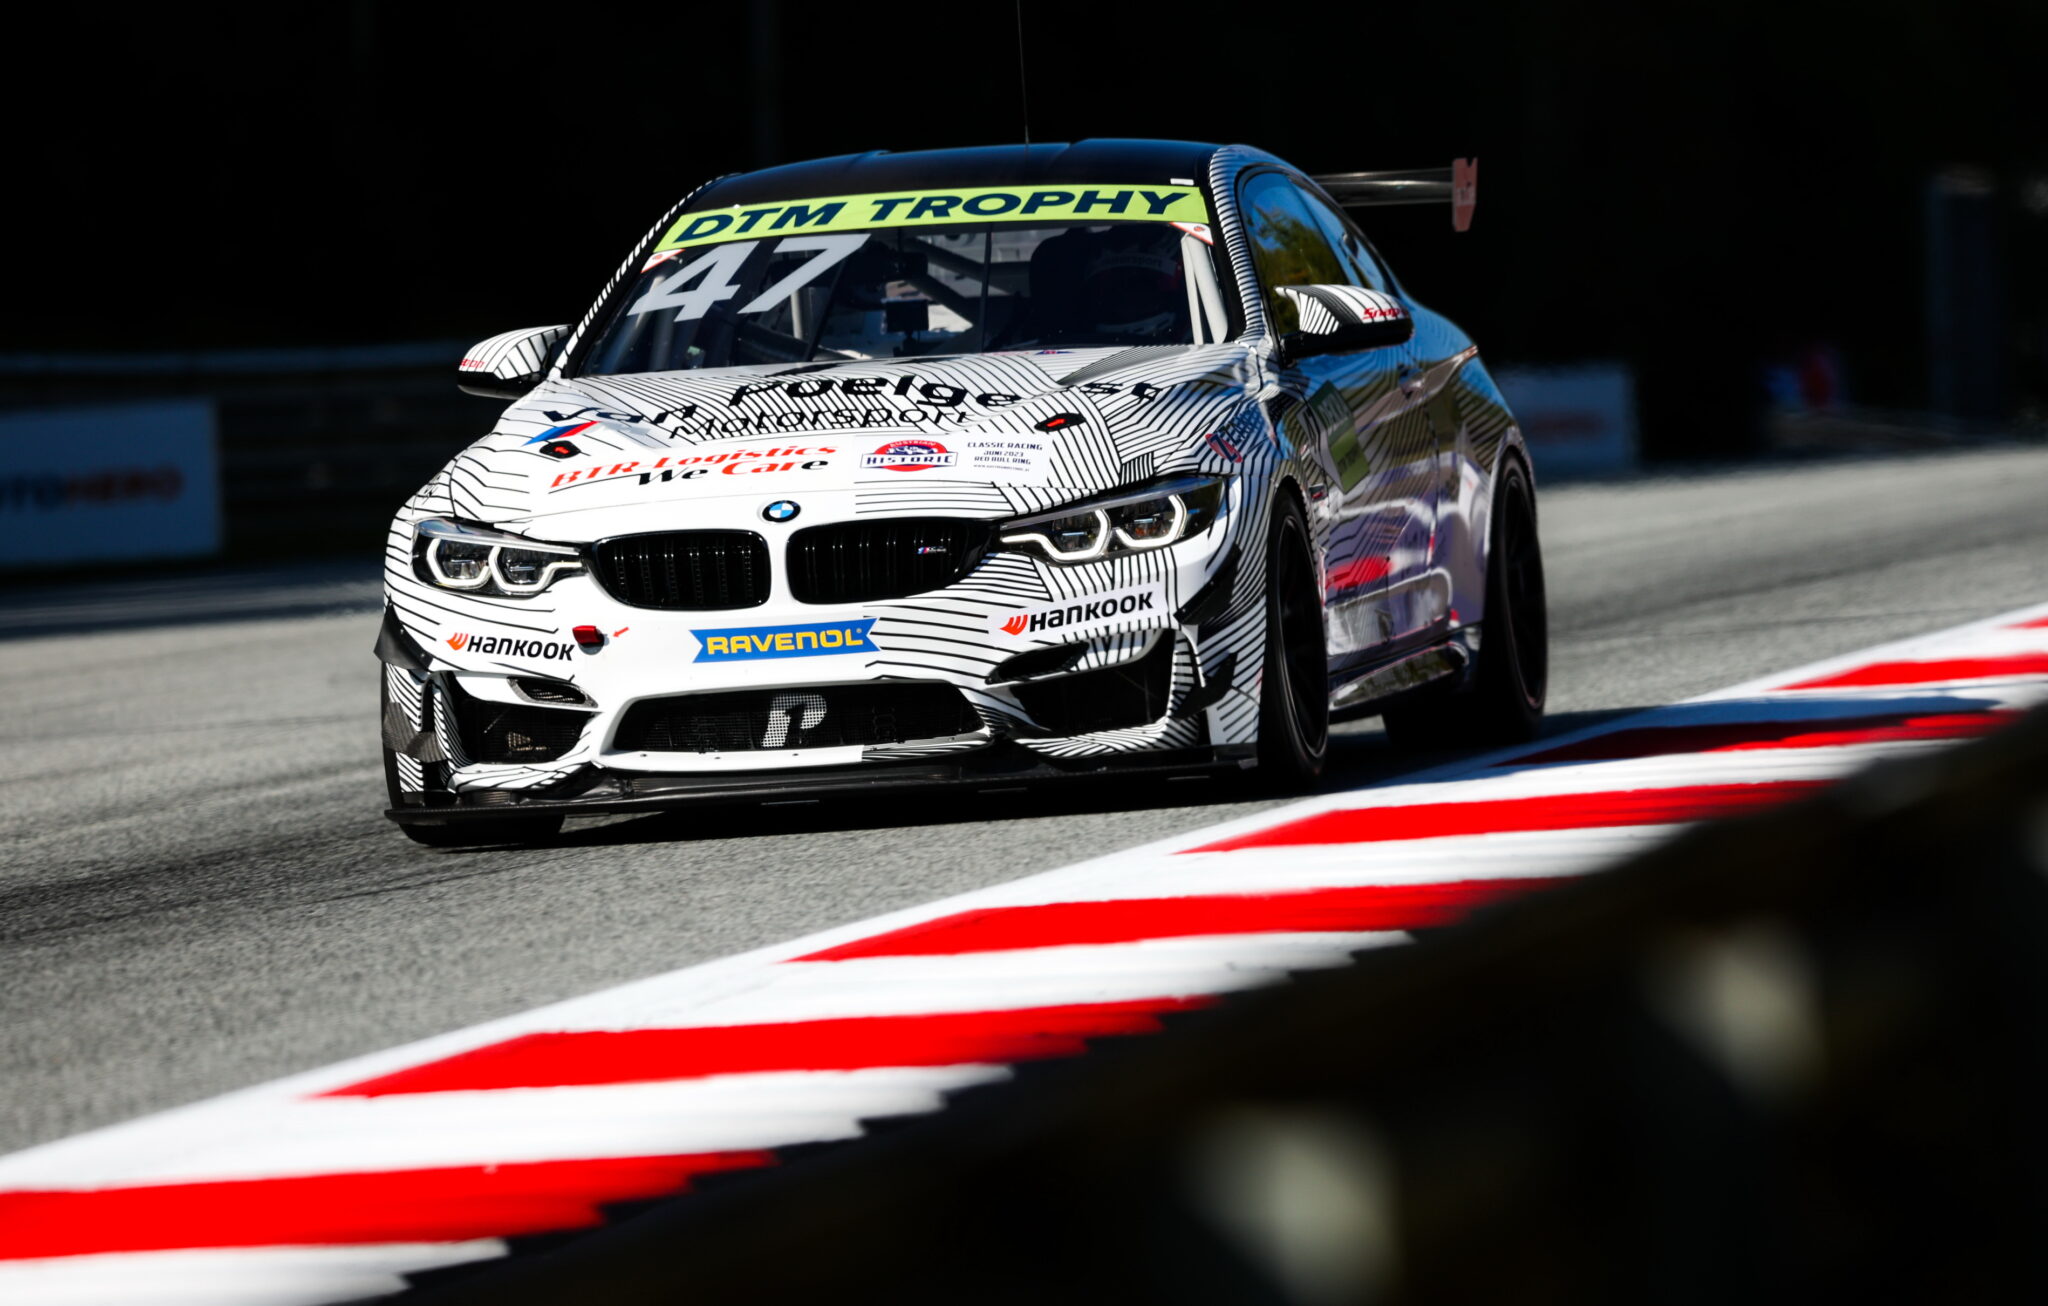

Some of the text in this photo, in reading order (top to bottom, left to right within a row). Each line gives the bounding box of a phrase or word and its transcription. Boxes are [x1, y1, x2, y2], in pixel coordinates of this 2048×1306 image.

[672, 190, 1194, 244] DTM TROPHY
[626, 233, 871, 322] 47
[866, 455, 953, 465] HISTORIC
[1007, 443, 1043, 451] RACING
[550, 445, 837, 488] BTR-Logistics
[638, 459, 829, 485] We Care
[706, 628, 865, 654] RAVENOL
